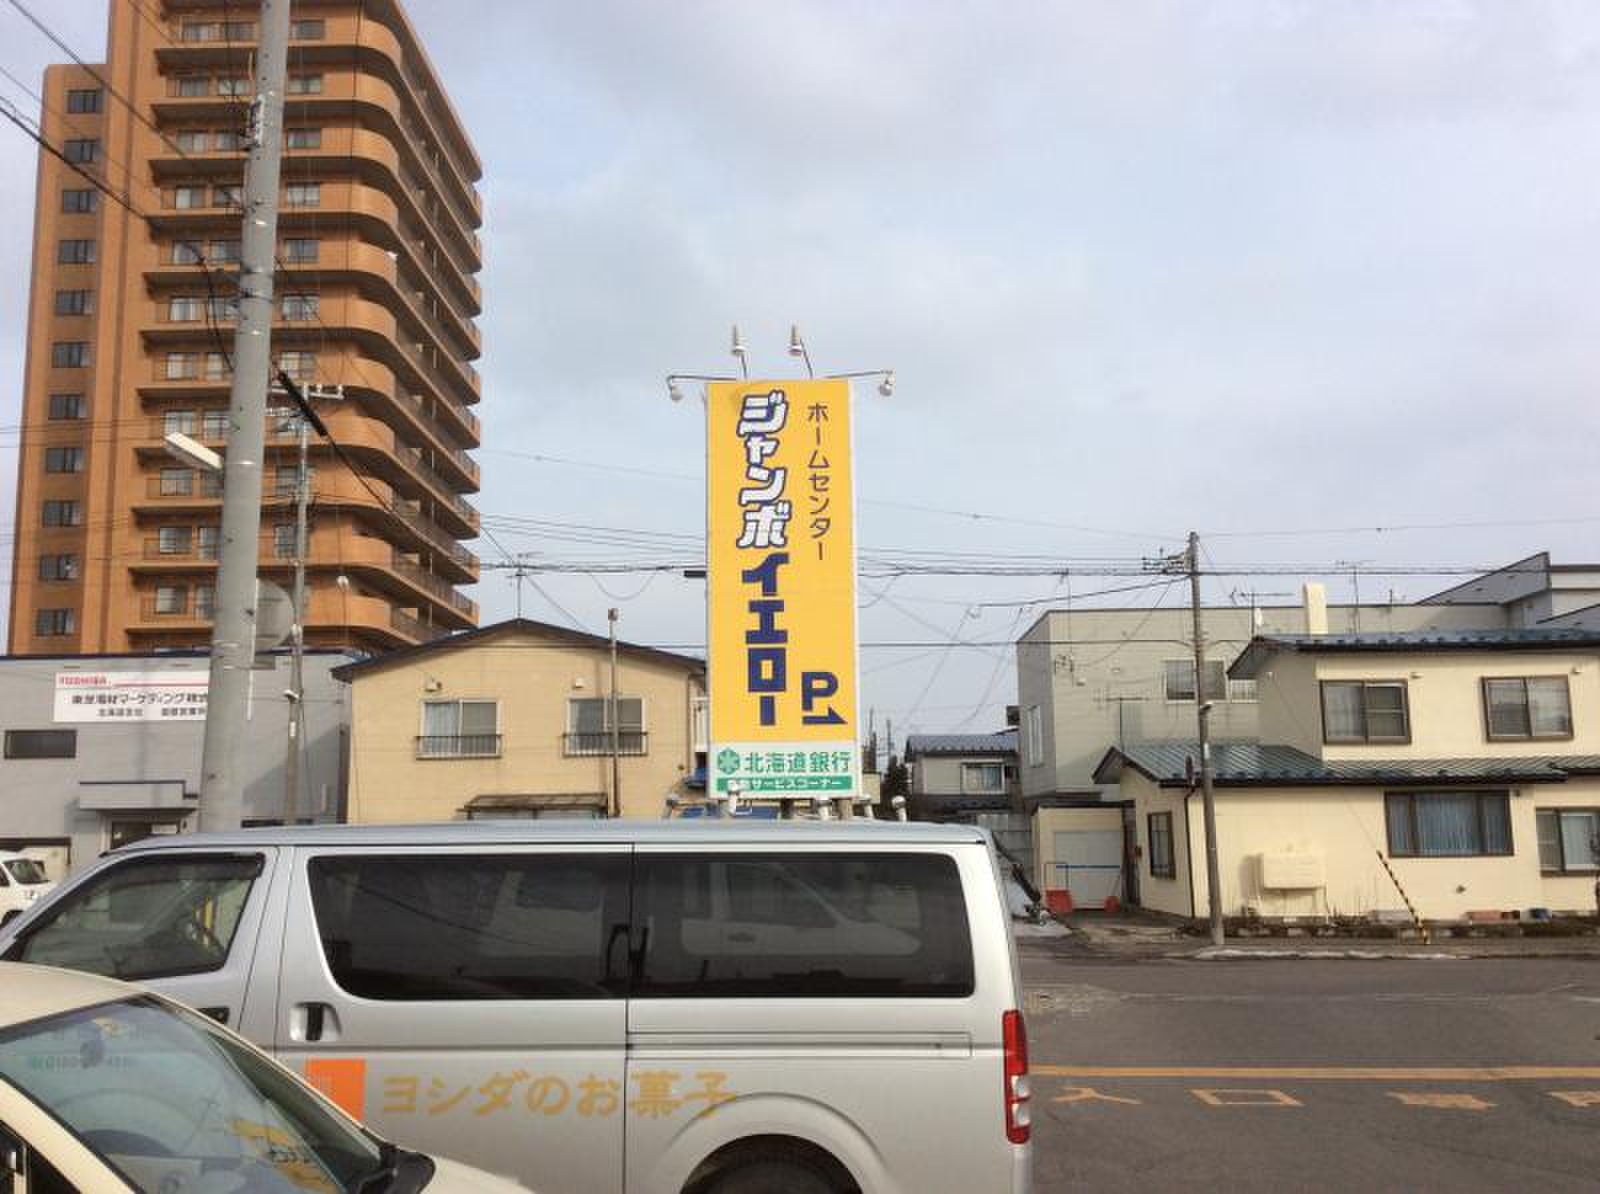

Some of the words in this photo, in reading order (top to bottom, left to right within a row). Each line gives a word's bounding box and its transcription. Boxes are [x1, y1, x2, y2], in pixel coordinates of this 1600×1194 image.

[807, 402, 832, 561] ホームセンター
[801, 671, 839, 711] P
[744, 751, 851, 774] 北海道銀行
[383, 1069, 738, 1119] ヨシダのお菓子
